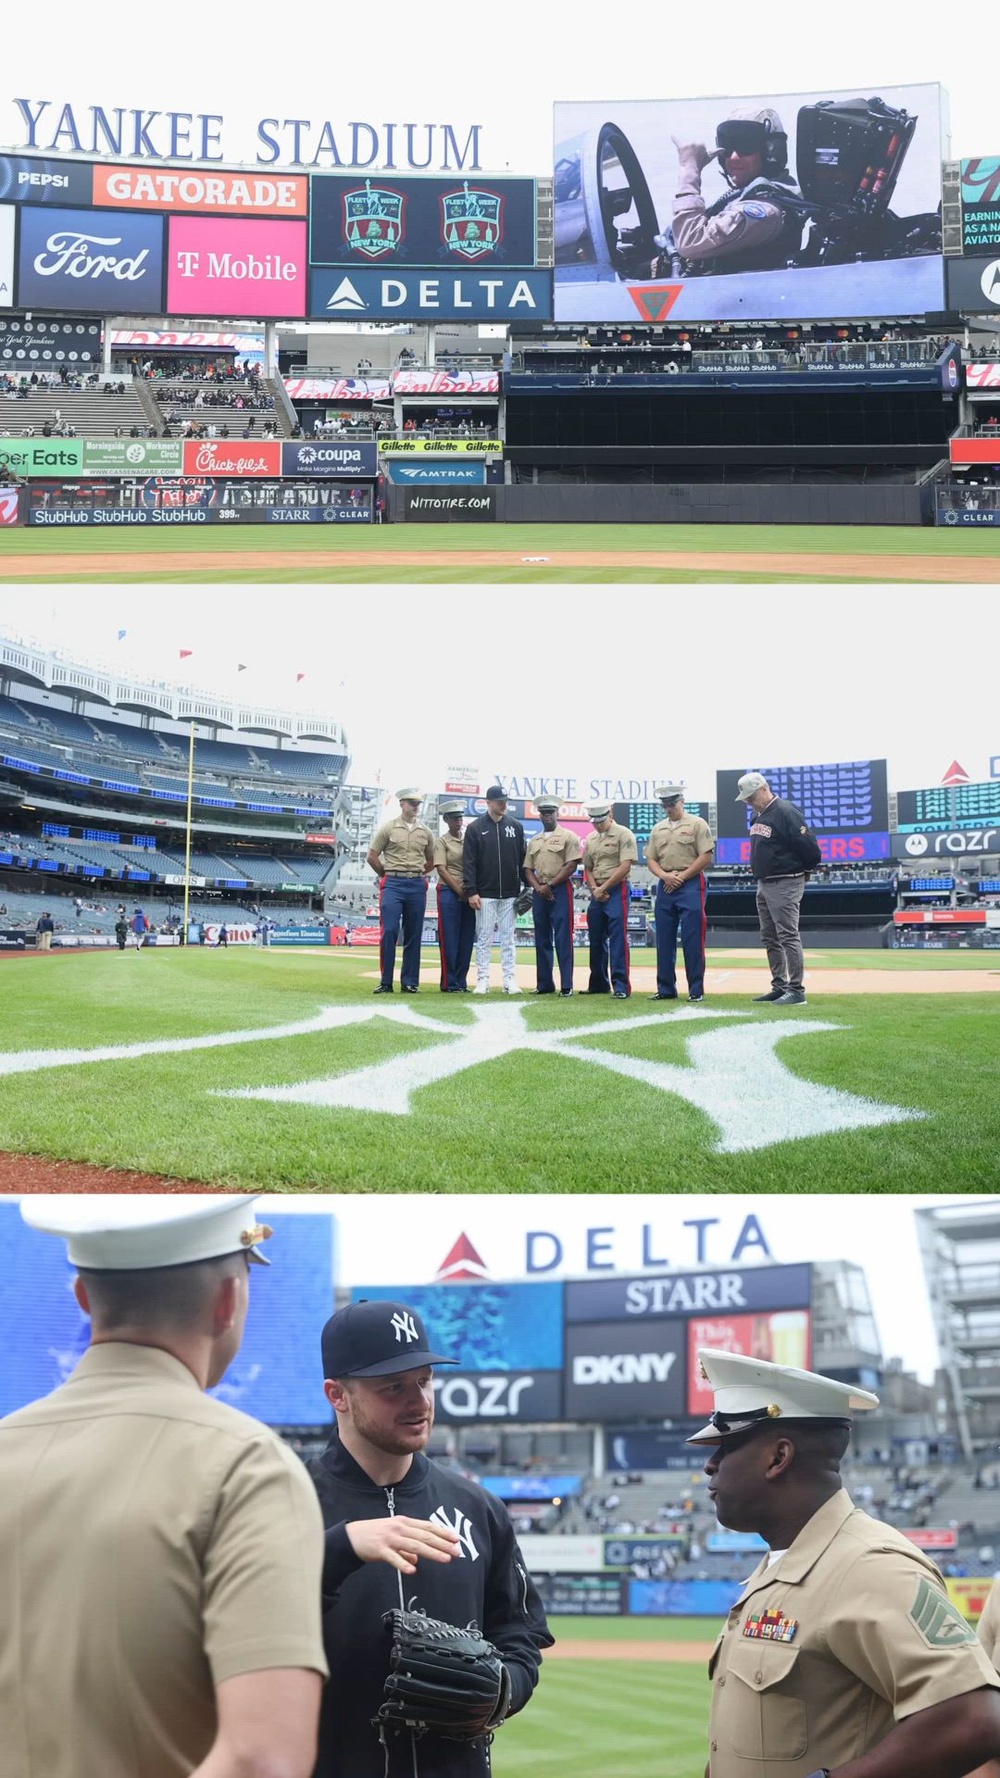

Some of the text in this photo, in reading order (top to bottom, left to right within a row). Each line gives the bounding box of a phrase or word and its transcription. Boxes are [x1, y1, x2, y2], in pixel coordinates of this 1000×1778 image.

[12, 98, 483, 171] YANKEE STADIUM
[18, 171, 69, 188] PEPSI
[106, 172, 297, 208] GATORADE
[964, 224, 979, 234] AS
[981, 223, 988, 233] A
[350, 239, 396, 249] NEW YORK
[448, 240, 495, 250] NEW YORK
[34, 232, 149, 281] Ford
[178, 252, 297, 281] T Mobile
[381, 280, 537, 308] DELTA
[6, 334, 24, 347] York
[752, 364, 777, 372] StubHub
[86, 441, 125, 452] Morningside
[381, 442, 500, 451] Gillette Gillette Gillette
[33, 449, 78, 466] Eats
[317, 449, 361, 464] coupa
[410, 496, 491, 509] NITTOTIRE.COM
[35, 509, 206, 523] StubHub StubHub StubHub
[271, 510, 311, 521] STARR
[494, 775, 577, 800] YANKEE
[935, 830, 996, 852] razr
[525, 1214, 772, 1274] DELTA
[625, 1273, 748, 1315] STARR
[572, 1352, 676, 1386] DKNY
